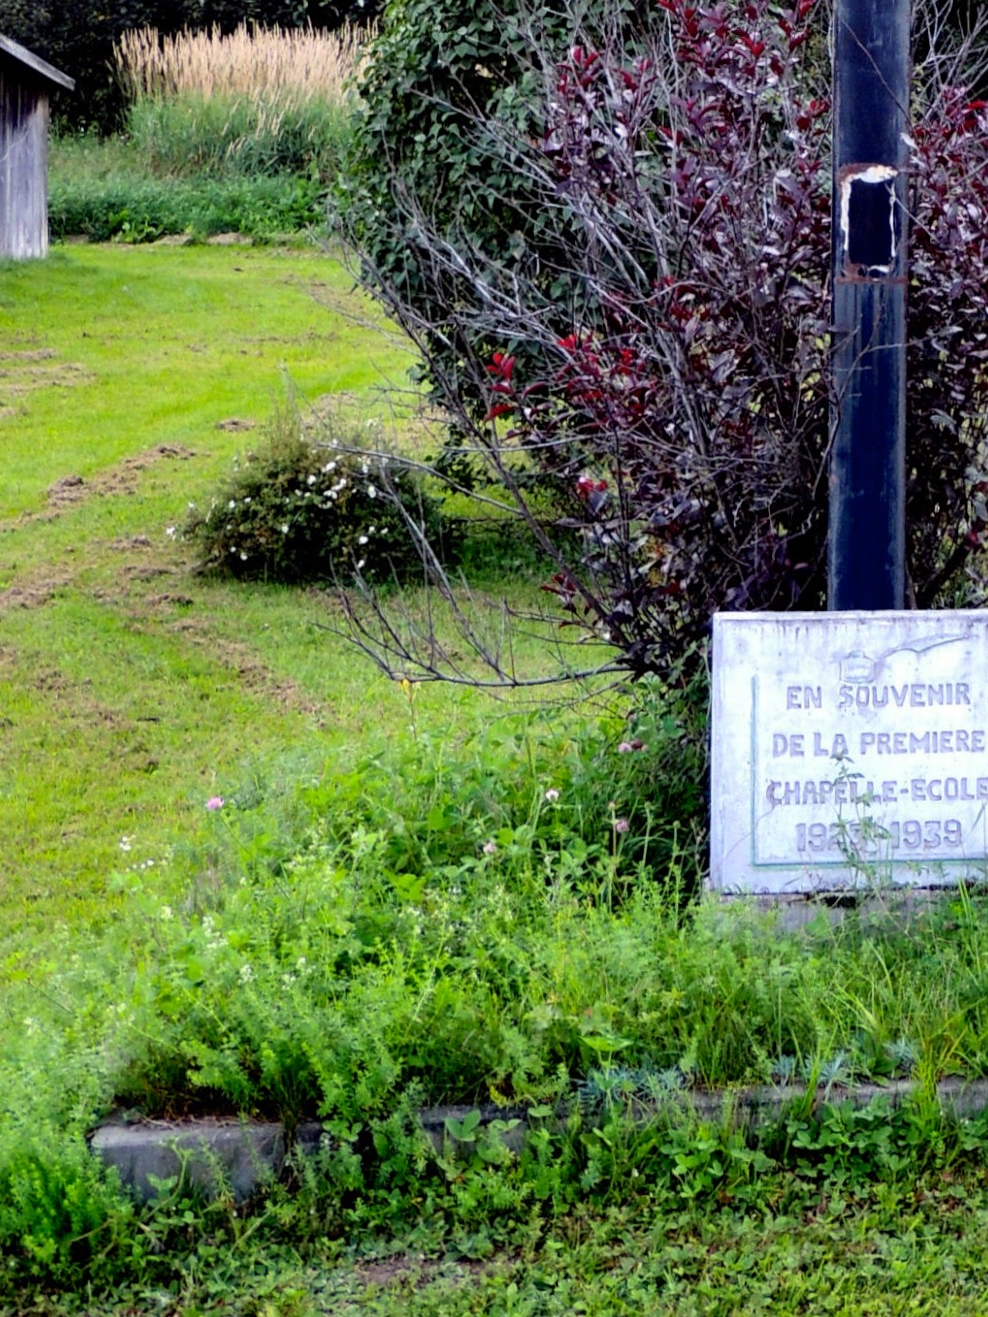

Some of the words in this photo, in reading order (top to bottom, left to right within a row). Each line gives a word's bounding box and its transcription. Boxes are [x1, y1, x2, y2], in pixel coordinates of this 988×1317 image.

[786, 686, 822, 708] EN
[839, 683, 970, 708] SOUVENIR
[773, 733, 804, 756] DE
[814, 732, 848, 755] LA
[860, 730, 985, 754] PREMIERE
